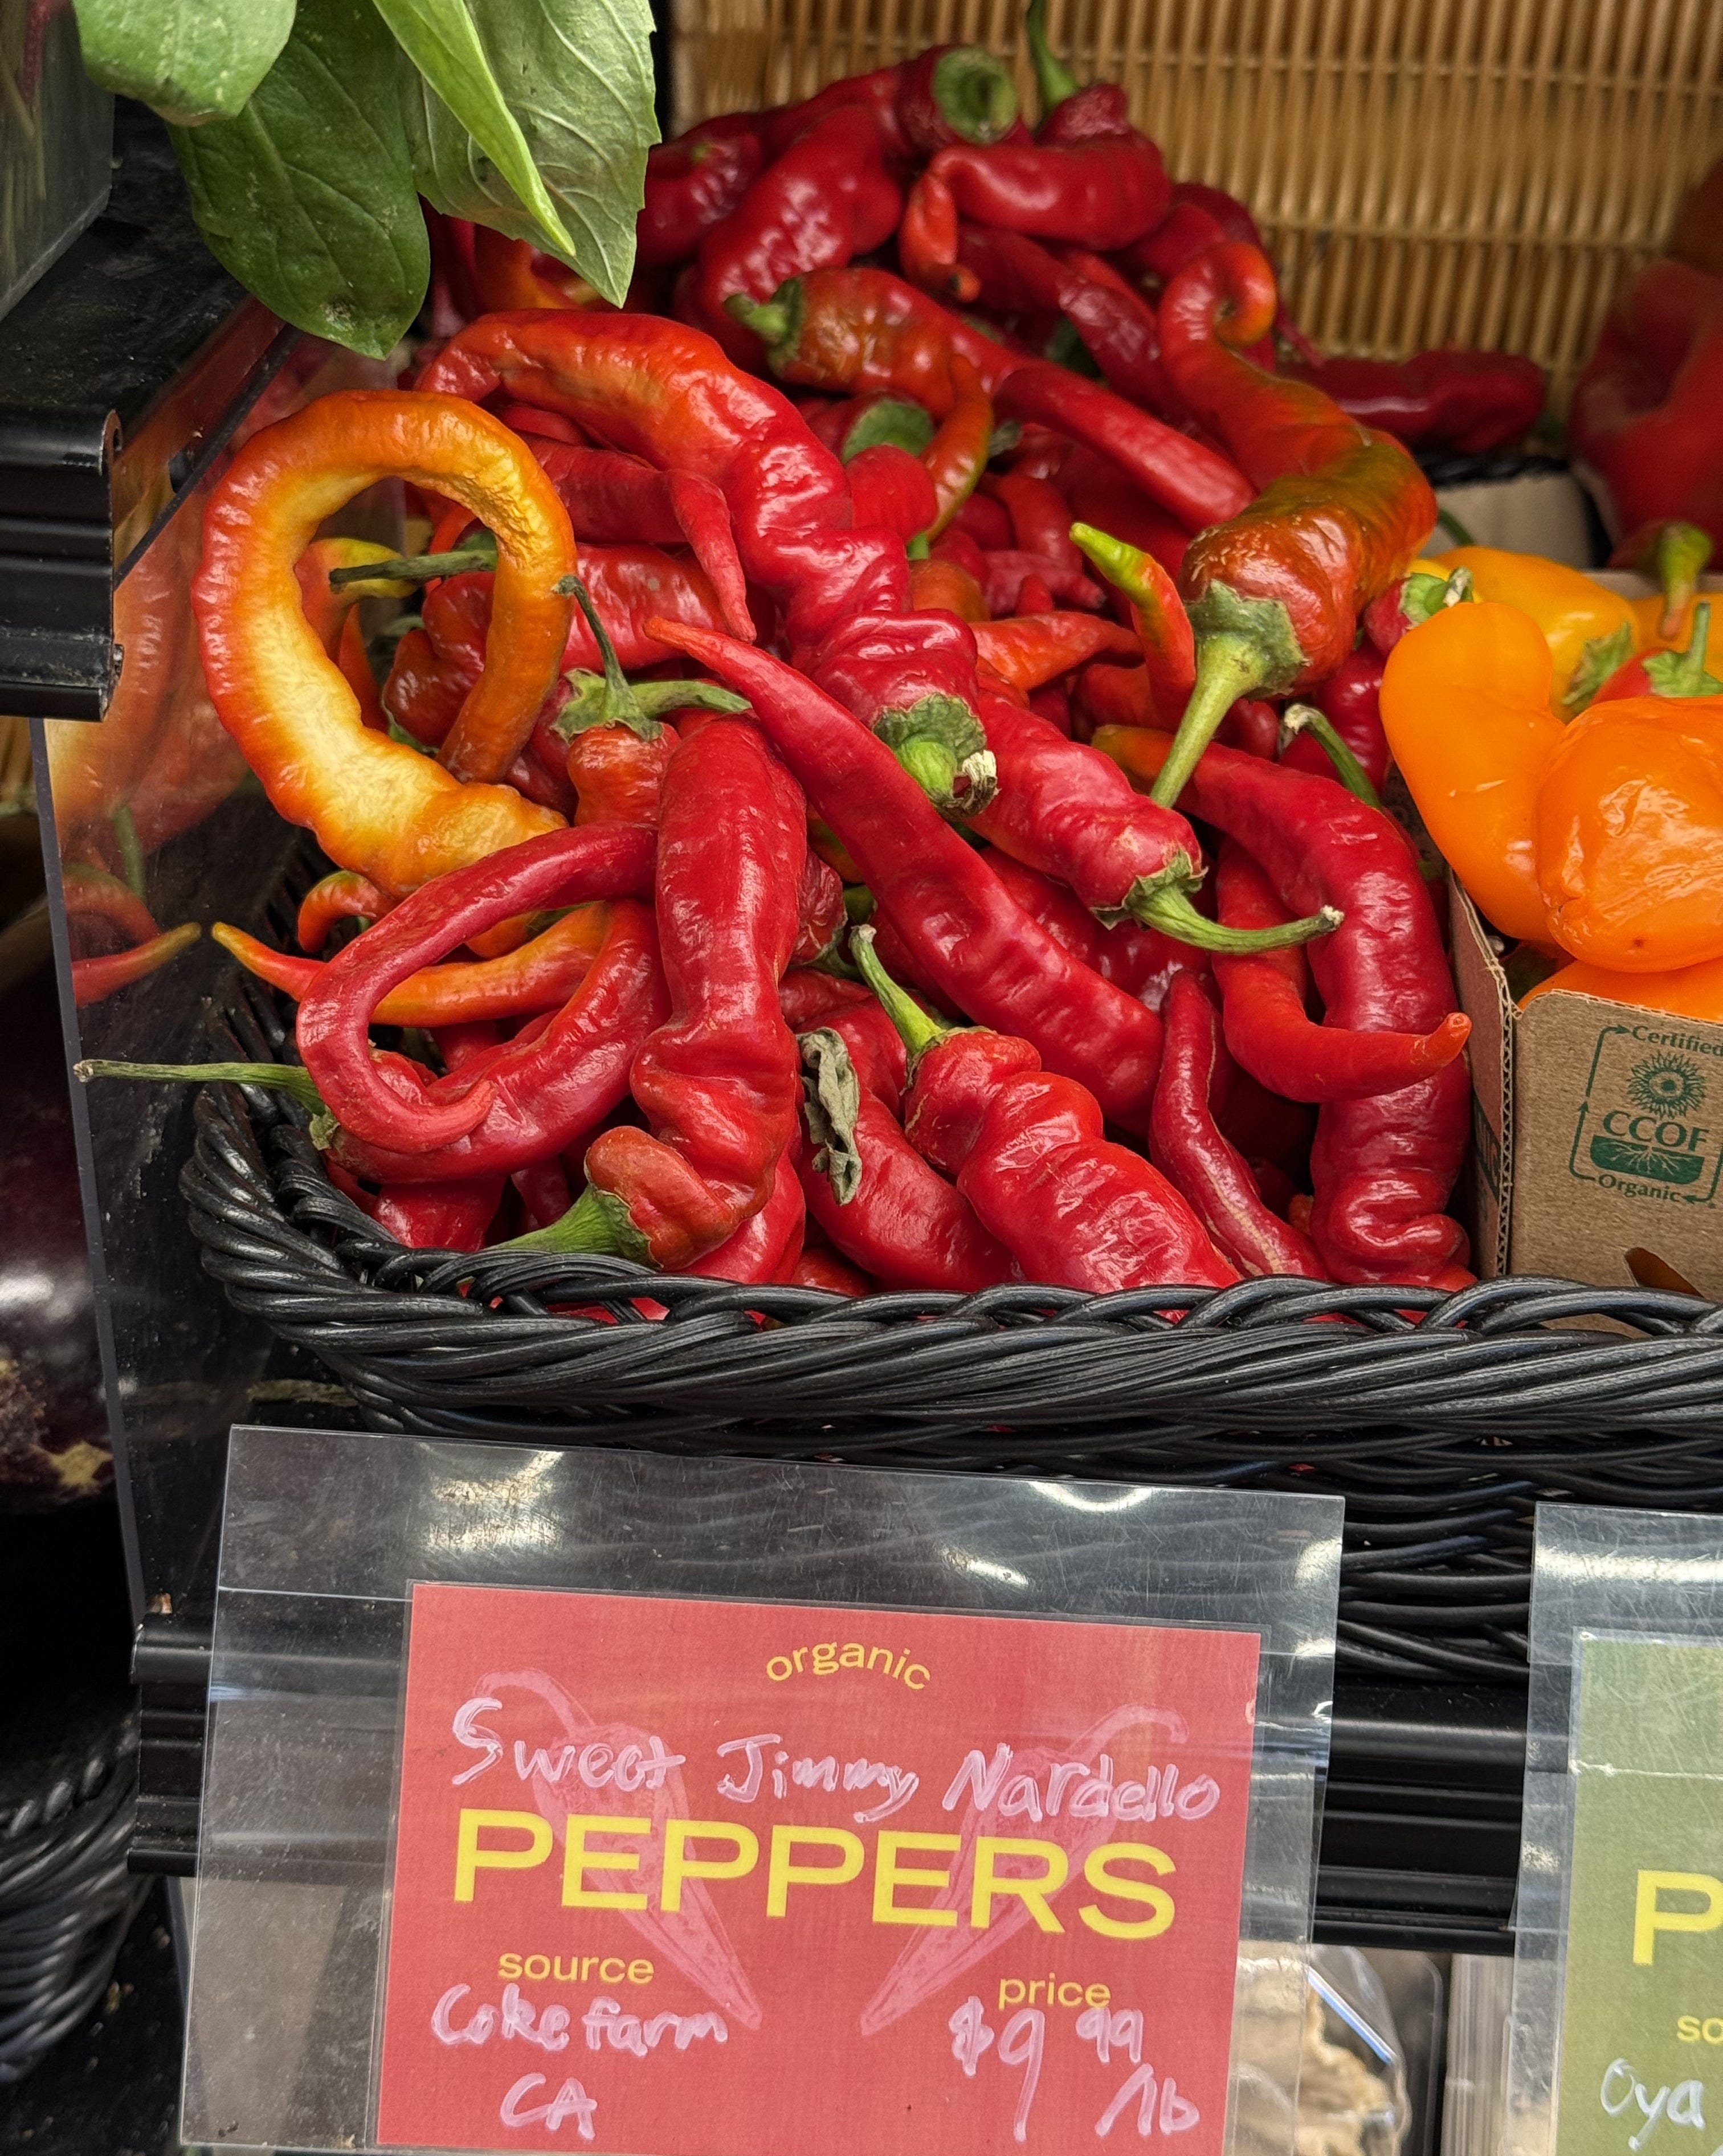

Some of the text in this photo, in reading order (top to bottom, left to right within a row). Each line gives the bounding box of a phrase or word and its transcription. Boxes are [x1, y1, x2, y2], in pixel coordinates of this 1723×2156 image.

[1632, 1025, 1723, 1056] Certified
[1602, 1110, 1709, 1151] CCOF
[1598, 1174, 1680, 1202] Organic
[766, 1643, 932, 1690] organic
[452, 1697, 1220, 1823] Sweet Jimmy Nardello
[454, 1808, 1177, 1939] PEPPERS
[498, 1953, 655, 1983] source
[998, 1973, 1111, 2010] price
[500, 2072, 598, 2140] CA
[1095, 2062, 1200, 2137] /lb
[1600, 2058, 1705, 2151] Oya
